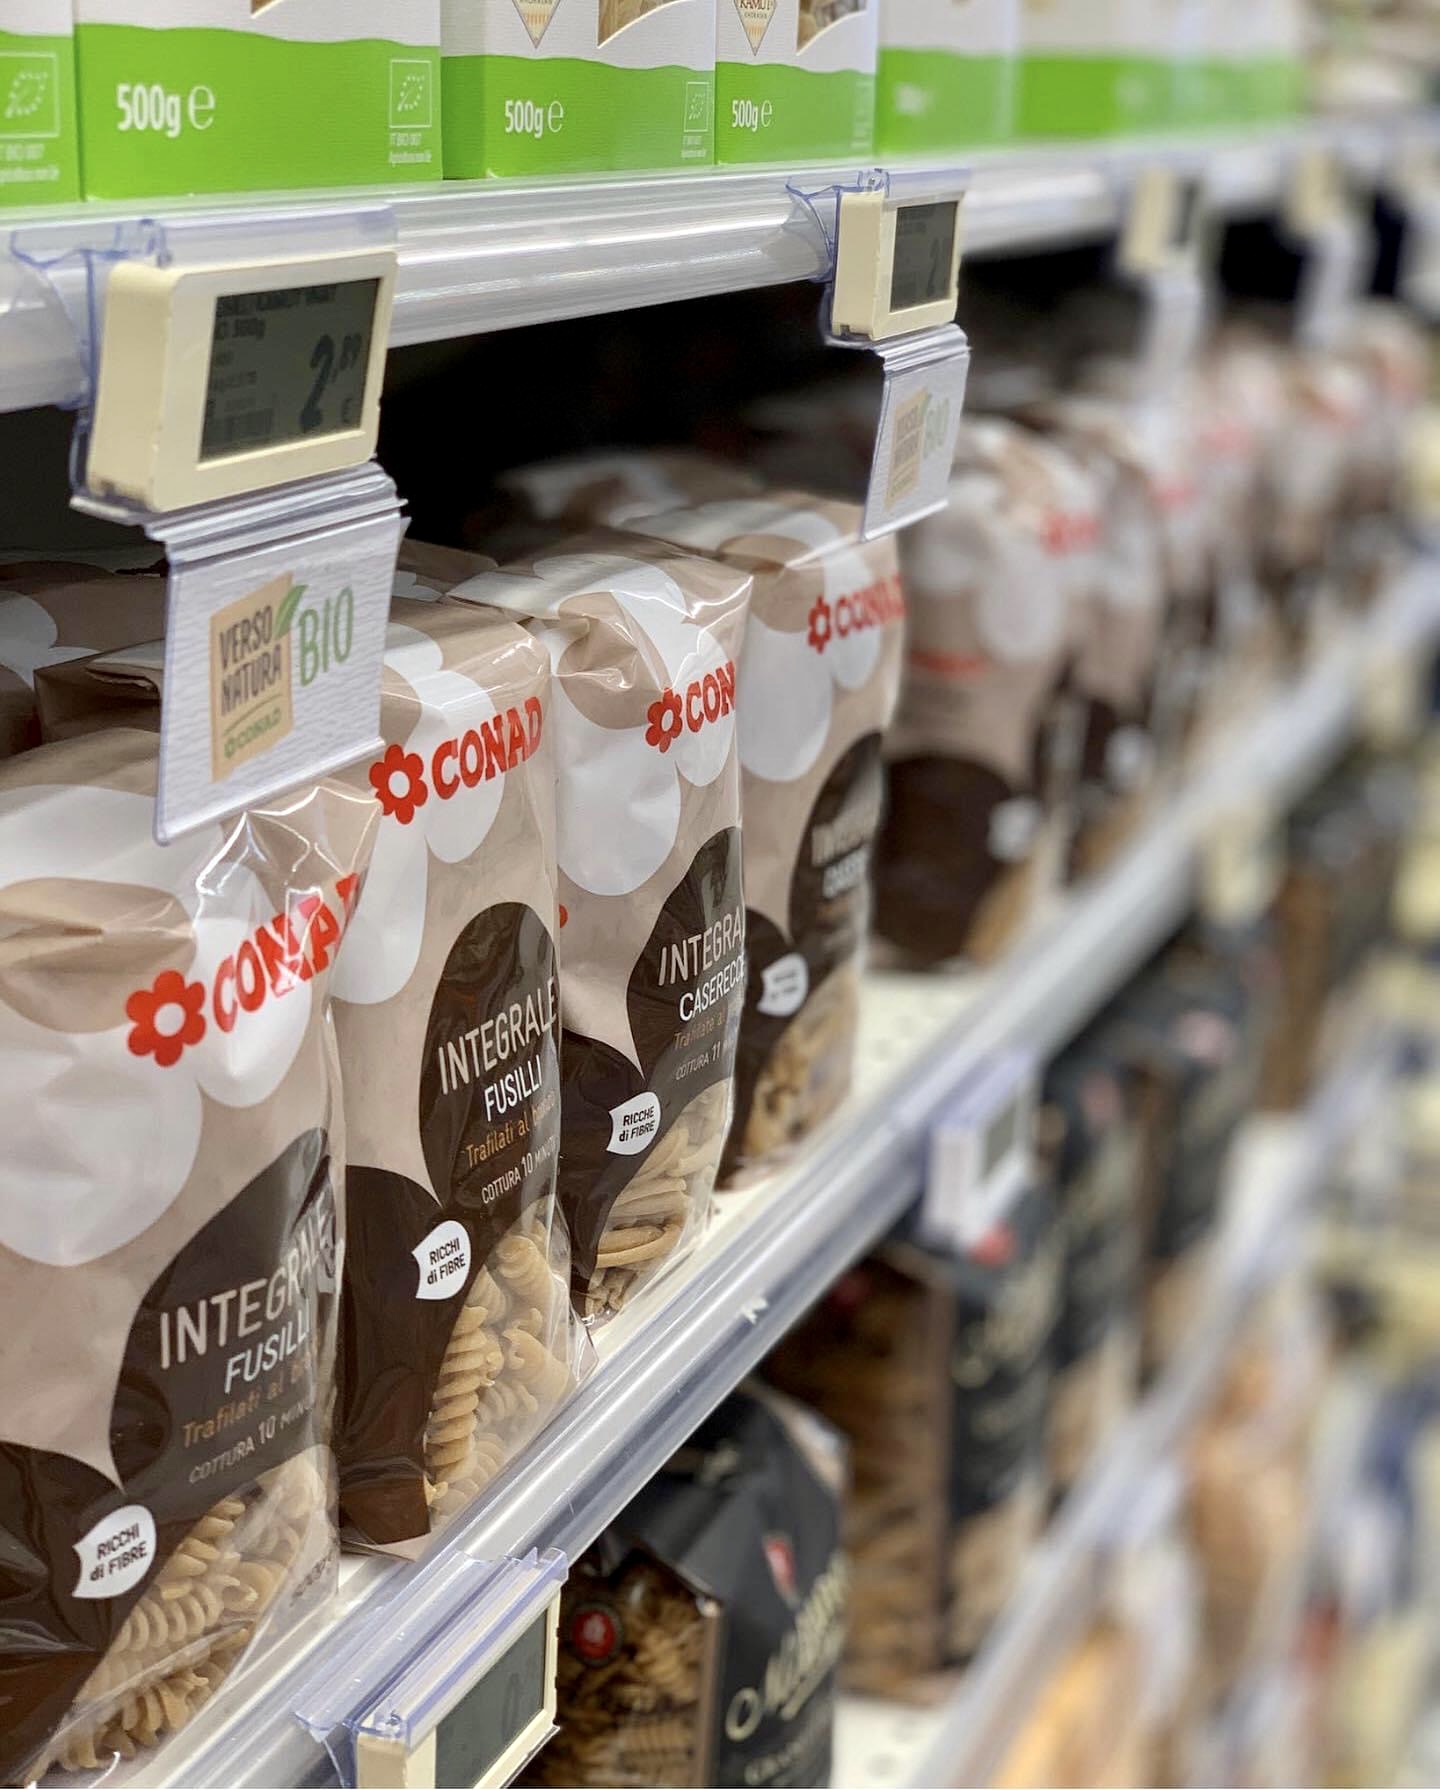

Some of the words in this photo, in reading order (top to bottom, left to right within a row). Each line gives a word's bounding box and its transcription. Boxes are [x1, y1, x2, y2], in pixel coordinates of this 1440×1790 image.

[116, 82, 182, 138] 500g
[504, 99, 544, 139] 500g
[731, 99, 759, 132] 500g
[219, 604, 273, 670] VERSO
[299, 585, 355, 687] BIO
[221, 643, 283, 717] NATURA
[431, 696, 543, 801] CONAD
[437, 976, 557, 1096] INTEGRALE
[484, 1054, 543, 1122] FUSILLI
[675, 1052, 710, 1082] COTTURA
[466, 1120, 514, 1168] Trafilati
[518, 1110, 530, 1137] al
[619, 1127, 629, 1142] di
[631, 1120, 656, 1140] FIBRE
[623, 1105, 655, 1127] RICCHE
[482, 1166, 521, 1204] COTTURA
[521, 1152, 534, 1177] 10
[427, 1266, 438, 1286] di
[439, 1253, 467, 1281] FIBRE
[429, 1236, 461, 1266] RICCHI
[189, 1436, 255, 1484] COTTURA
[258, 1415, 276, 1445] 10
[90, 1563, 104, 1581] di
[108, 1540, 148, 1575] FIBRE
[97, 1522, 140, 1561] RICCHI
